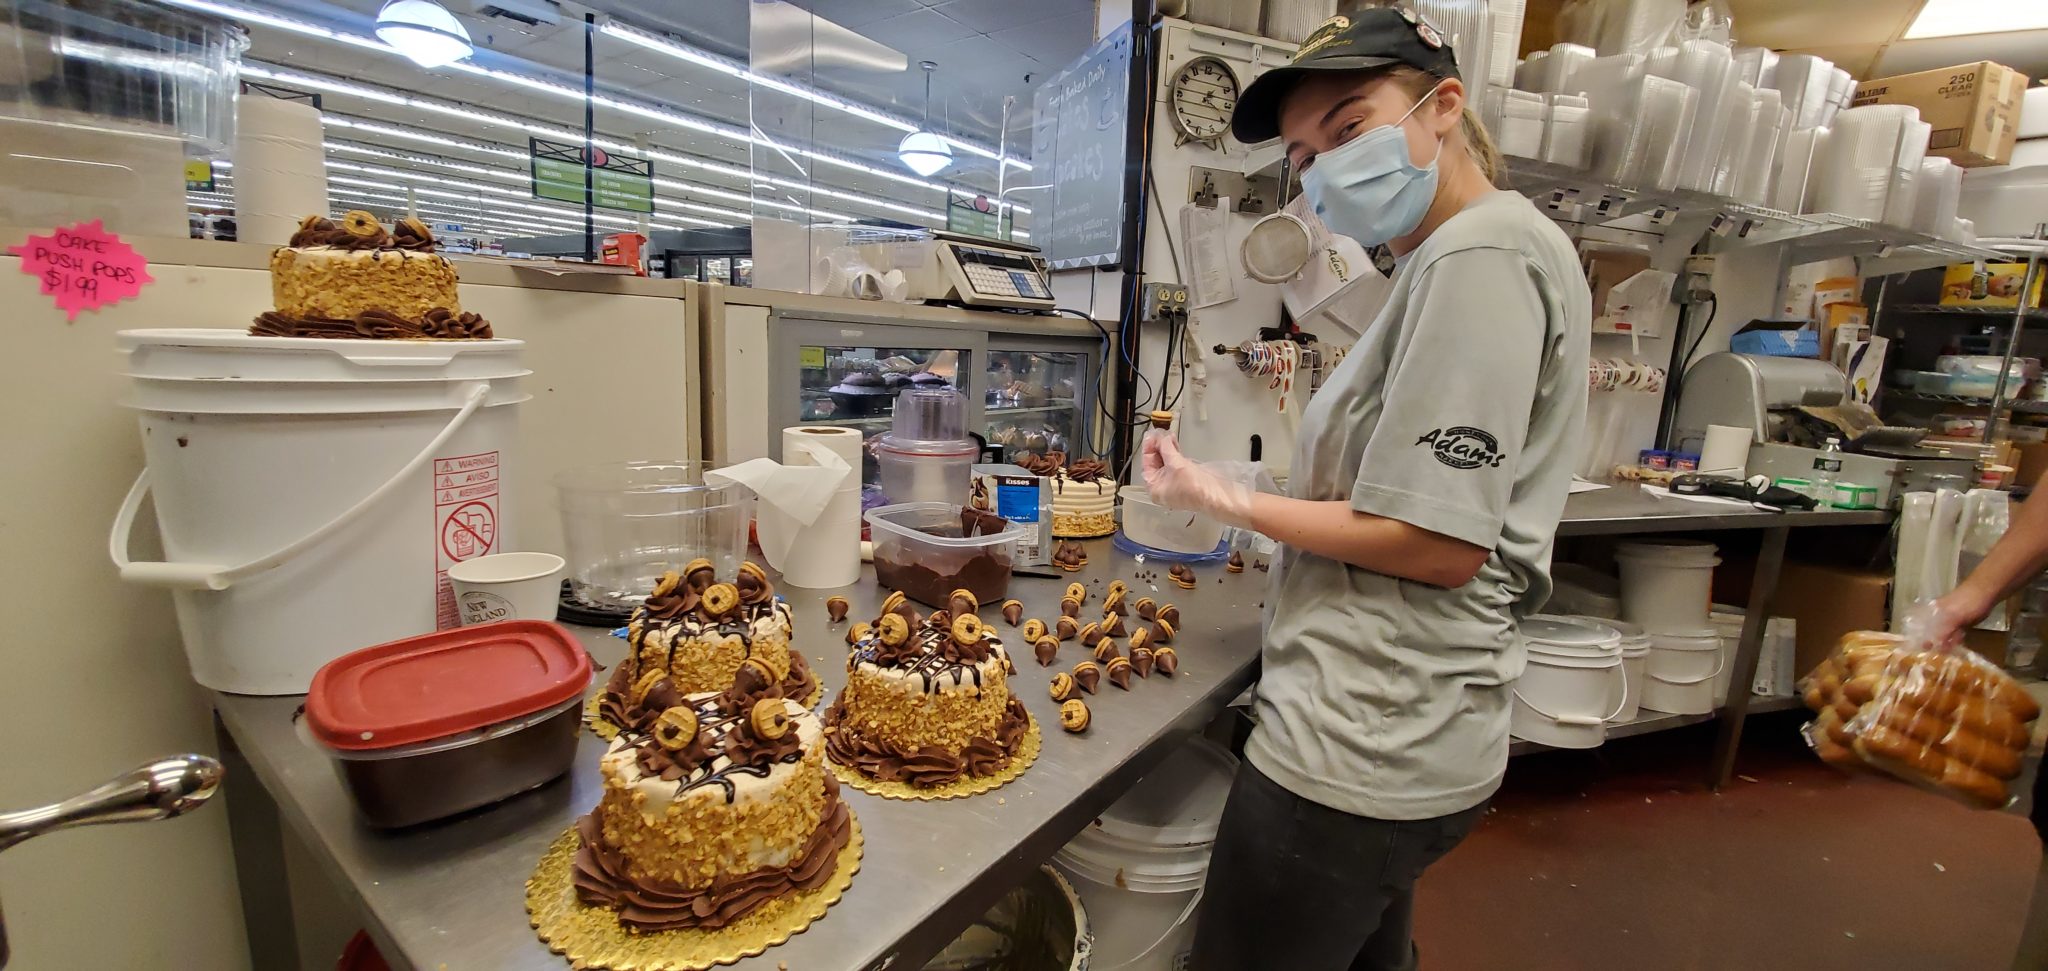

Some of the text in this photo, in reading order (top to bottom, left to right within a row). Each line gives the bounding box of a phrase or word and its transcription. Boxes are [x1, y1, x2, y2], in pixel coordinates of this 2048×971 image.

[1066, 76, 1086, 101] Baked
[1089, 63, 1106, 88] Daily
[1949, 73, 1975, 85] 250
[1938, 83, 1973, 95] CLEAR
[57, 233, 109, 254] CAKE
[35, 247, 136, 284] PUSH POPS
[1325, 248, 1348, 283] Adams
[1415, 428, 1506, 467] Adams
[458, 455, 495, 469] WARNING
[466, 471, 489, 482] AVISO
[467, 601, 487, 612] NEW
